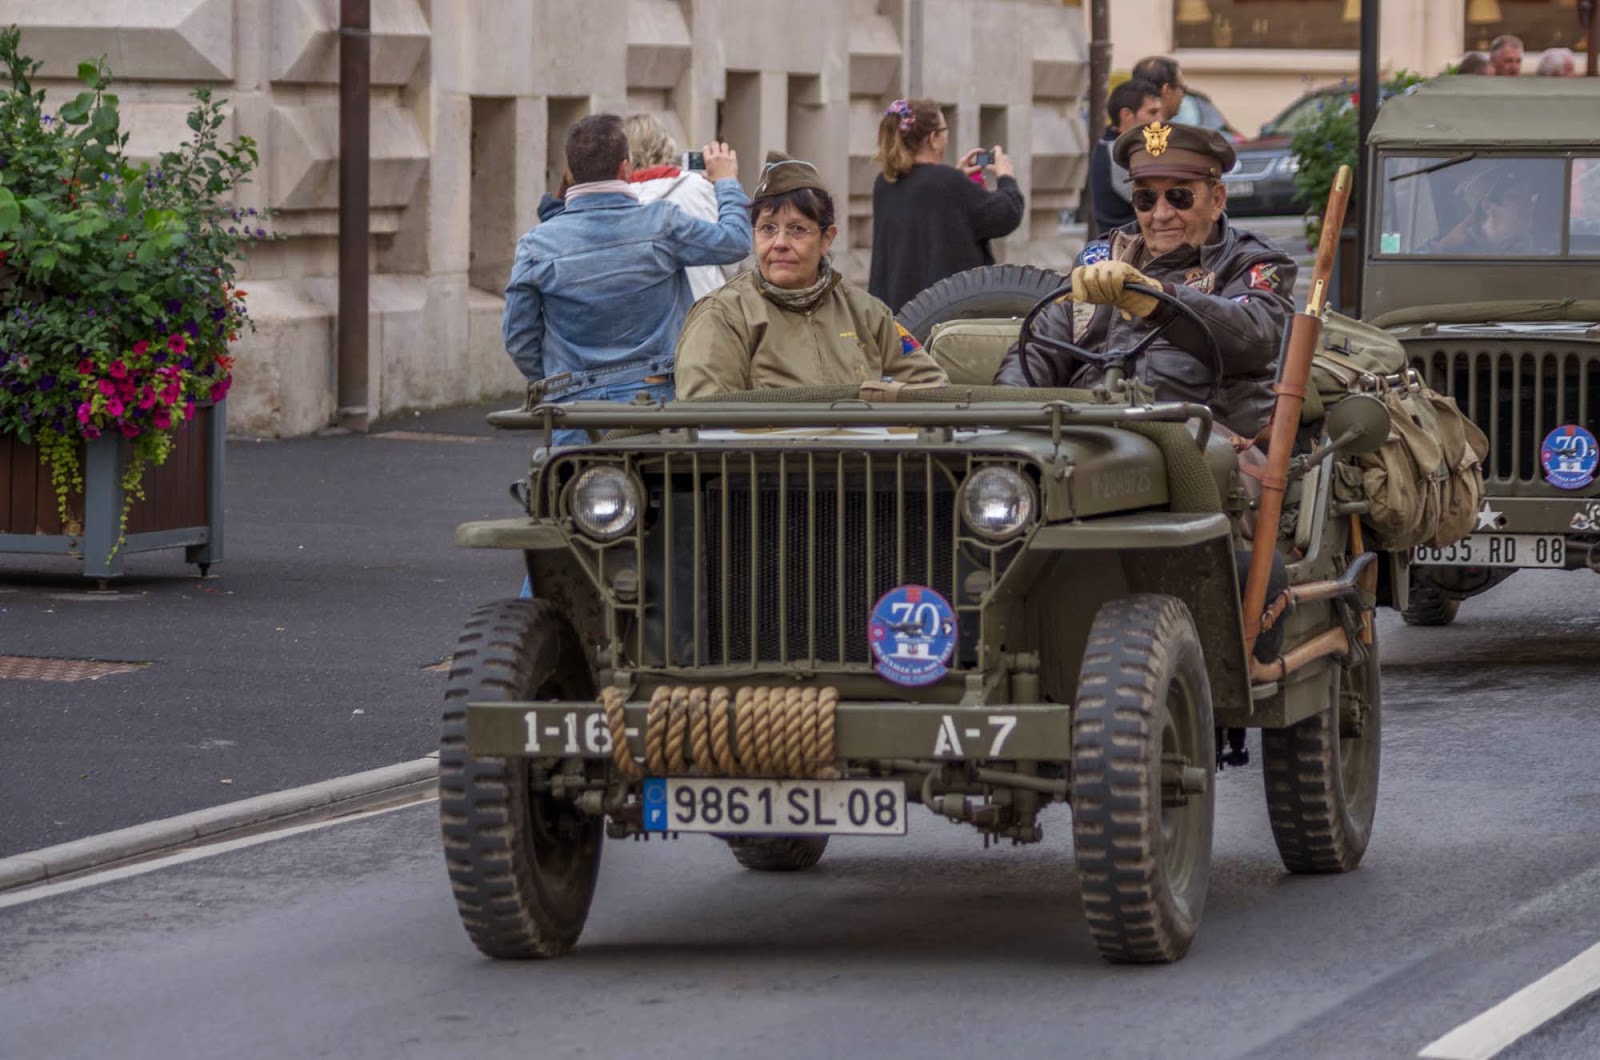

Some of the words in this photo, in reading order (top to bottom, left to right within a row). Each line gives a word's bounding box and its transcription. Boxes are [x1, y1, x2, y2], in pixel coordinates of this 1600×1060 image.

[1555, 435, 1588, 458] 70
[1489, 537, 1516, 563] RD
[1535, 538, 1563, 564] 08
[891, 602, 940, 637] 70
[933, 714, 1017, 756] A-7
[651, 809, 662, 823] F
[674, 785, 773, 825] 9861
[787, 787, 837, 826] SL
[847, 788, 898, 827] 08
